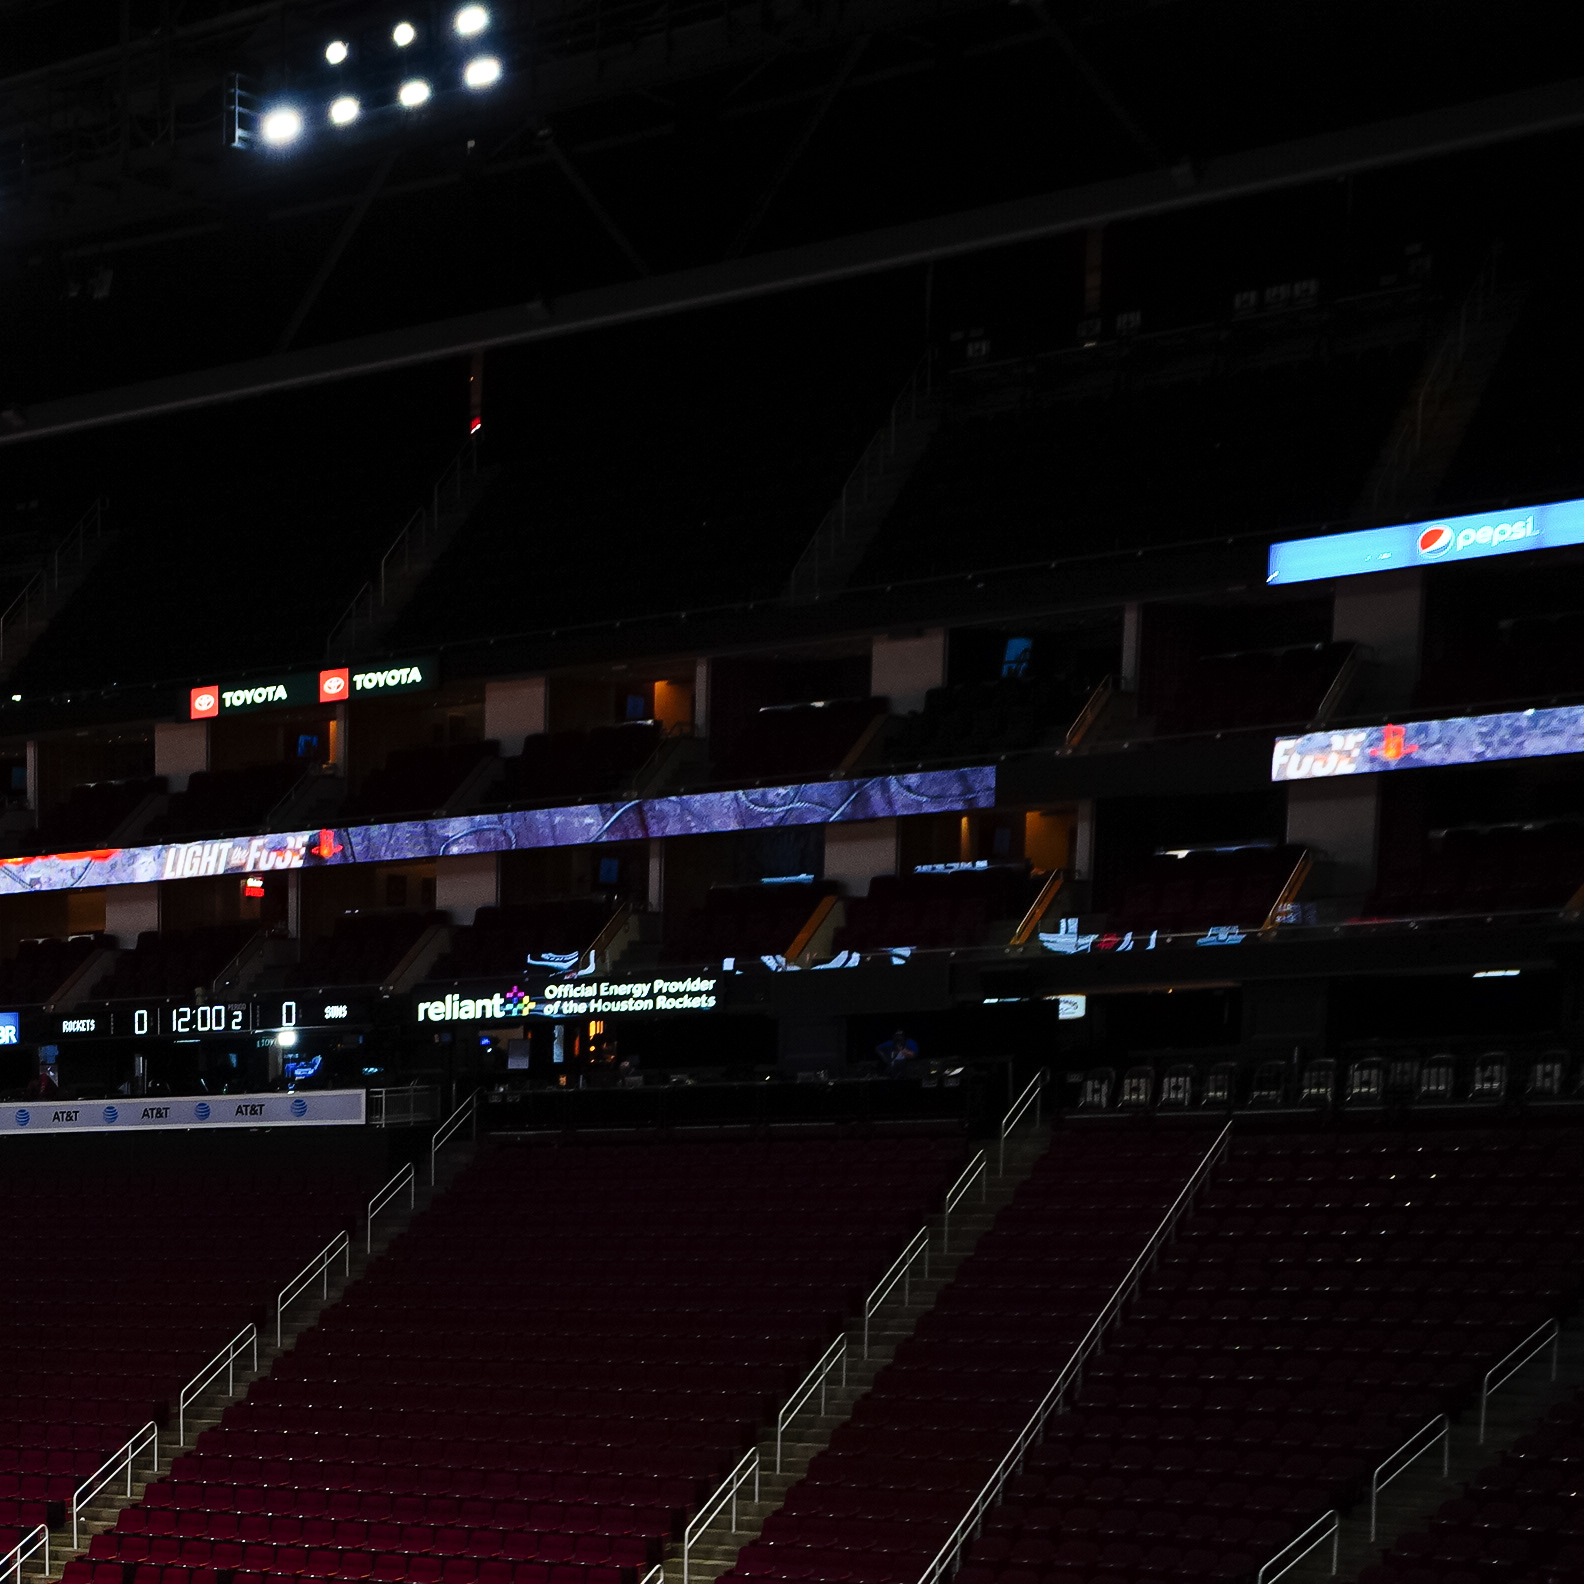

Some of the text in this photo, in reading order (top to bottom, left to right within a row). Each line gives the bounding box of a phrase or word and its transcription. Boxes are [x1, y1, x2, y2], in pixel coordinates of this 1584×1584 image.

[1455, 516, 1538, 556] pepsi
[352, 666, 423, 691] TOYOTA
[222, 684, 288, 708] TOYOTA
[163, 842, 233, 880] LIGHT
[247, 834, 310, 872] FUSE
[544, 976, 716, 1000] Official Energy Provider
[418, 993, 506, 1022] reliant
[543, 993, 716, 1016] of the Houston Rockets
[62, 1019, 96, 1033] ROCKETS
[134, 1010, 148, 1035] 0
[172, 1005, 225, 1032] 12:00
[282, 1001, 296, 1027] 0
[52, 1110, 80, 1123] AT&T
[141, 1106, 170, 1120] AT&T
[234, 1103, 266, 1118] AT&T
